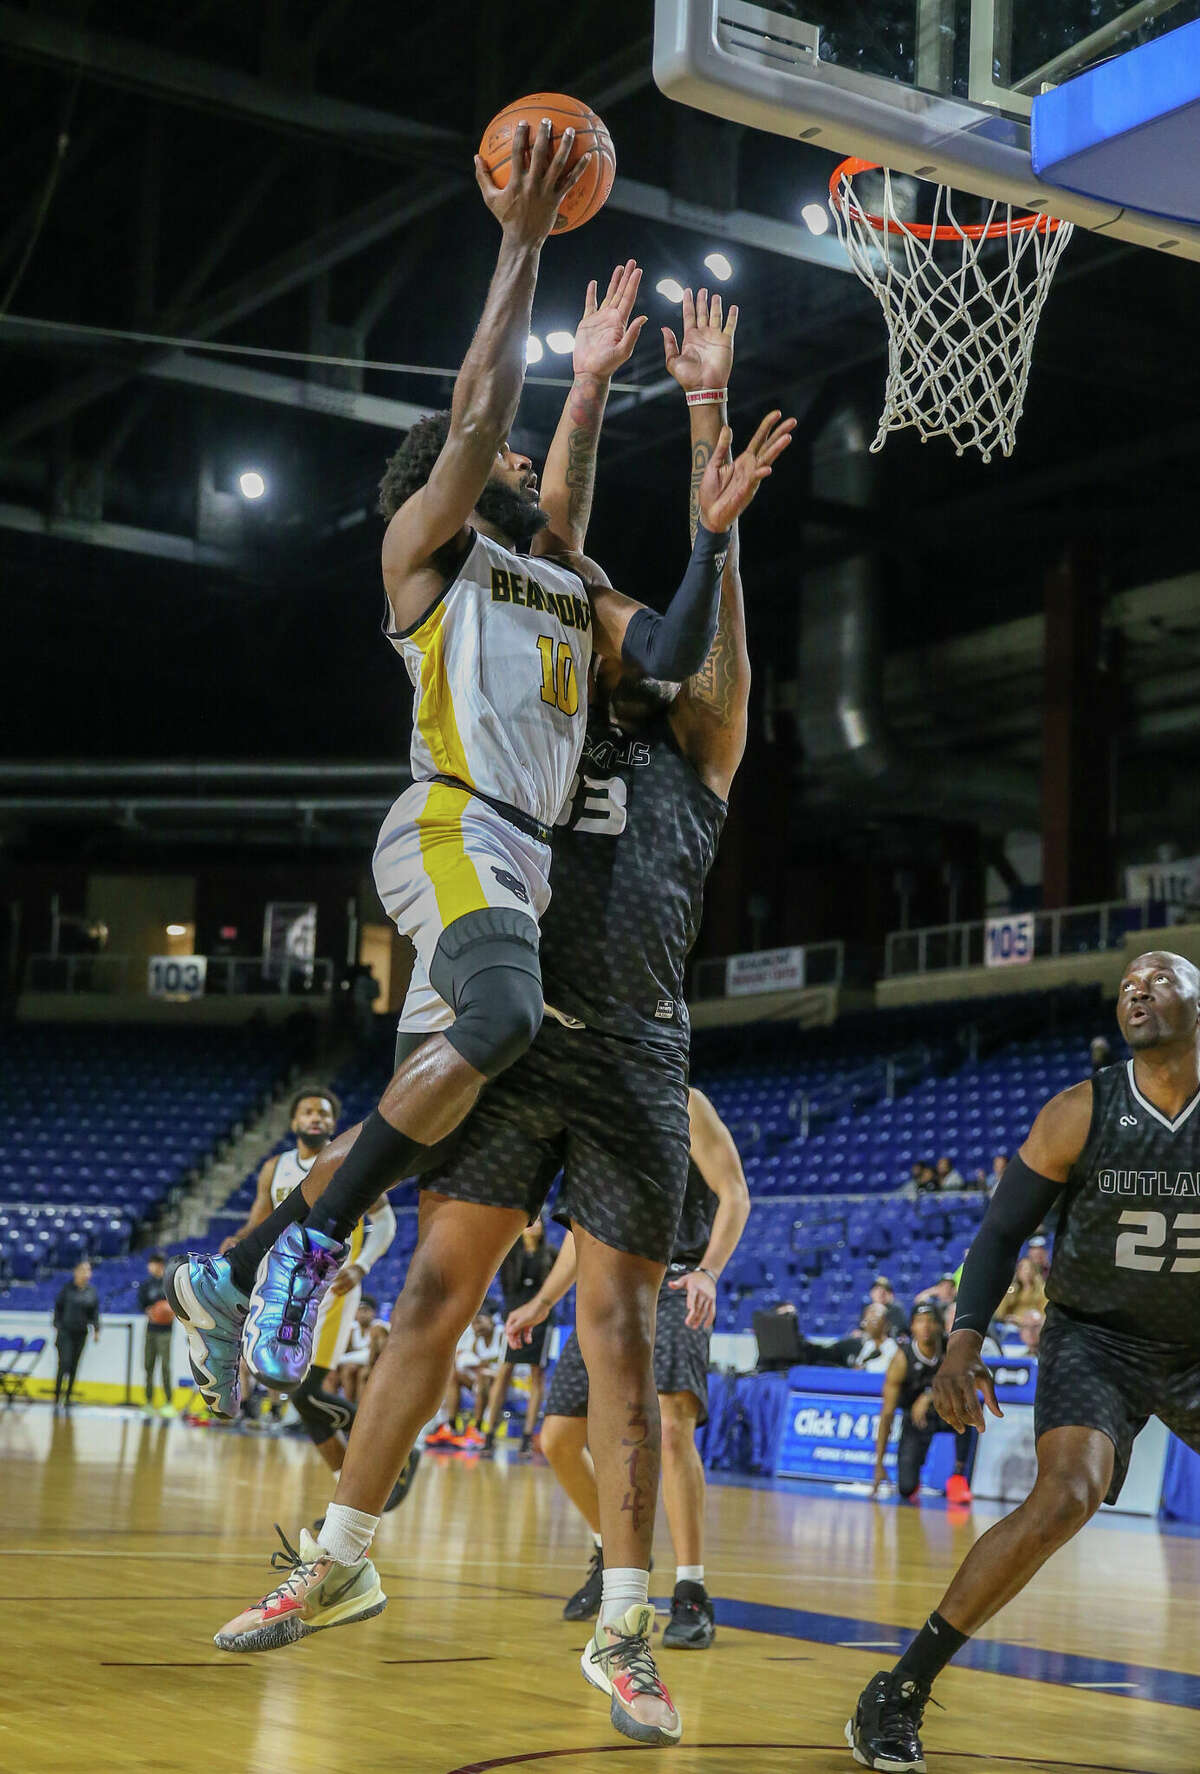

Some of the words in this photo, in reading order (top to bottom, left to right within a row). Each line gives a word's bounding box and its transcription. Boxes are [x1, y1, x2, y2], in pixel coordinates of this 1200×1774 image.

[536, 635, 578, 717] 10
[553, 773, 627, 836] 3
[988, 921, 1028, 959] 105
[153, 962, 200, 992] 103
[1098, 1168, 1200, 1197] OUTLA
[1115, 1209, 1200, 1273] 23
[793, 1408, 837, 1439] Click
[853, 1413, 869, 1440] 4
